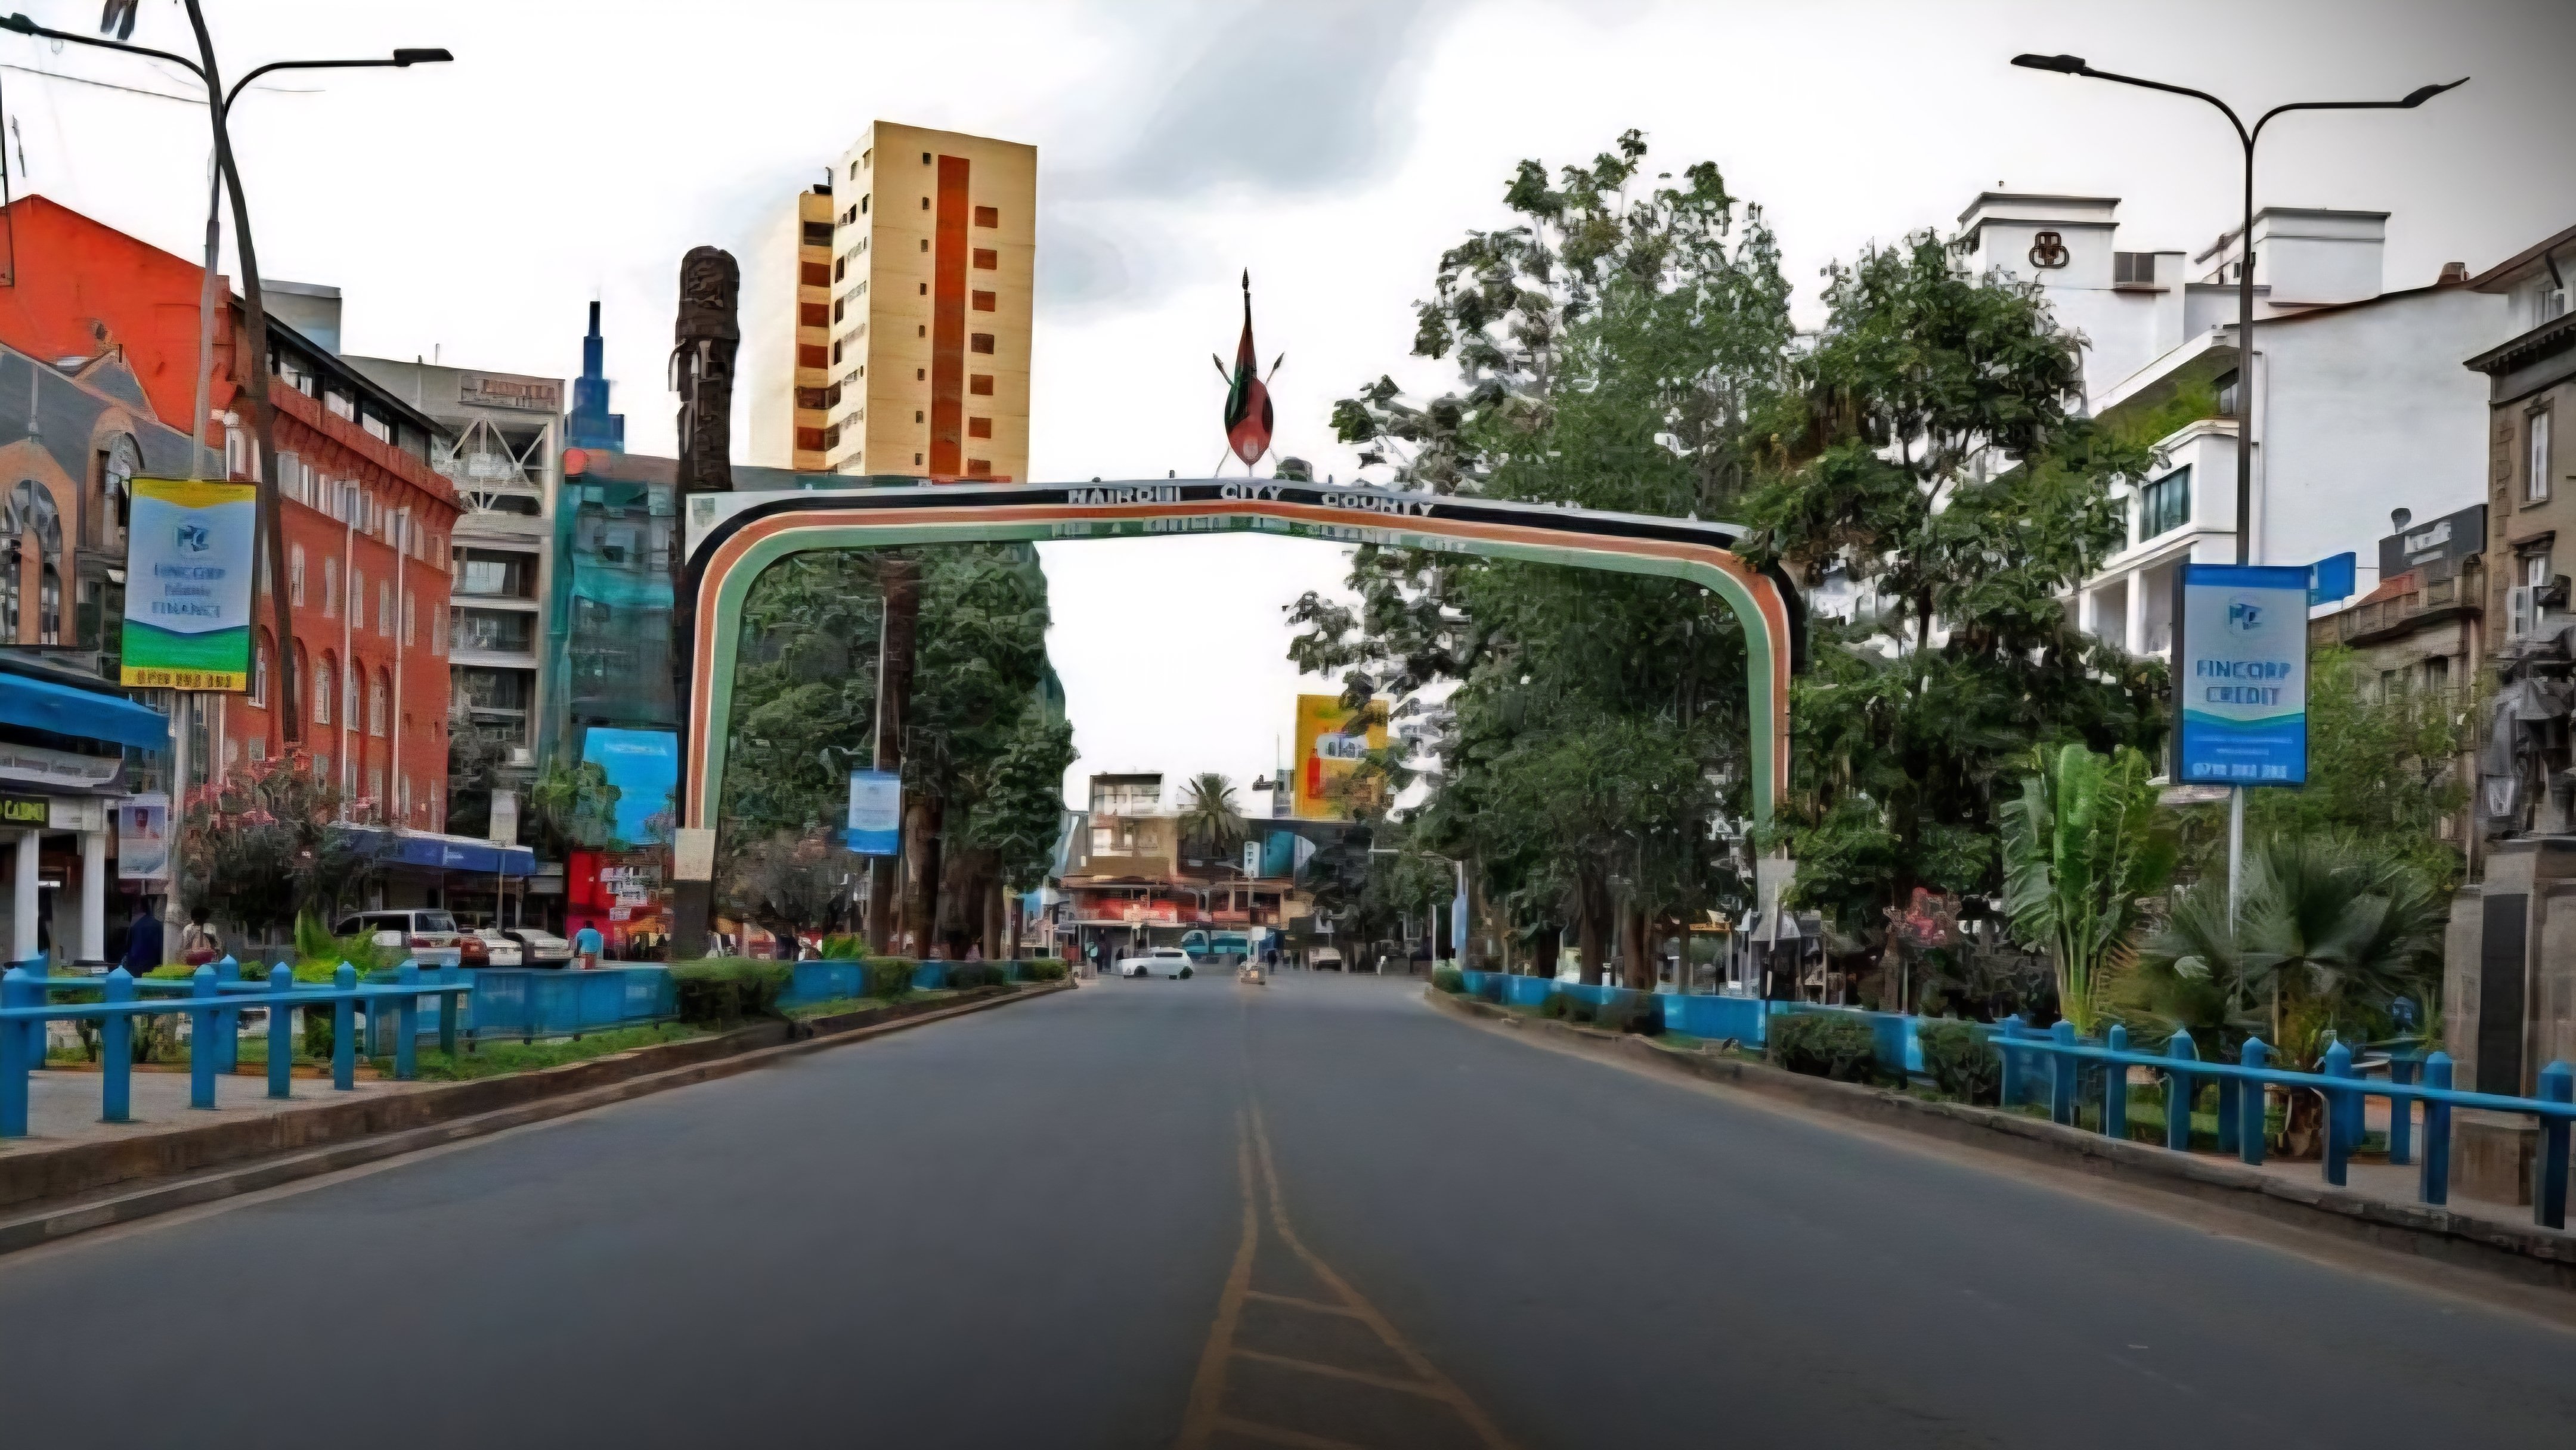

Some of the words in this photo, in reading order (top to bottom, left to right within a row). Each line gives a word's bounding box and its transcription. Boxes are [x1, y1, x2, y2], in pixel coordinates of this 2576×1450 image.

[1221, 482, 1284, 501] CITY
[1322, 493, 1433, 516] COUNTY
[2197, 659, 2291, 680] FINCORP
[2206, 686, 2281, 706] CREDIT
